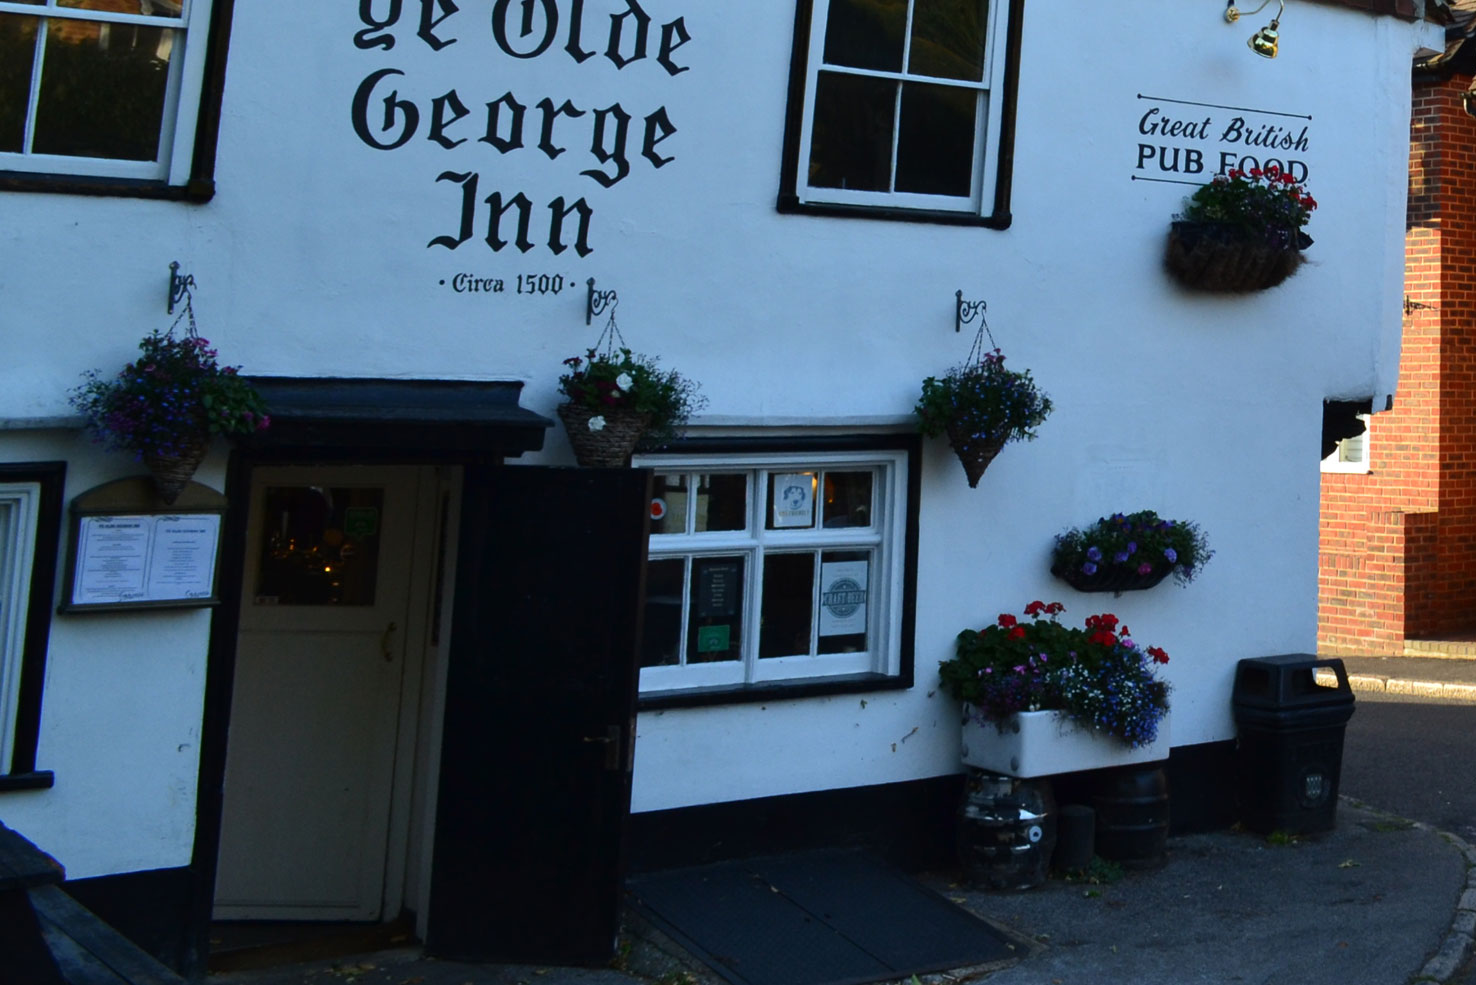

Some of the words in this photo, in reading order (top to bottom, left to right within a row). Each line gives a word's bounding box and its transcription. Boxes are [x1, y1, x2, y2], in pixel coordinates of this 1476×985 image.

[351, 68, 678, 188] George
[1138, 107, 1212, 140] Great
[1219, 117, 1310, 152] British
[1136, 143, 1205, 174] PUB
[1218, 151, 1309, 185] FOOD
[426, 171, 594, 259] Inn
[452, 273, 504, 293] Circa
[516, 274, 564, 295] 1500
